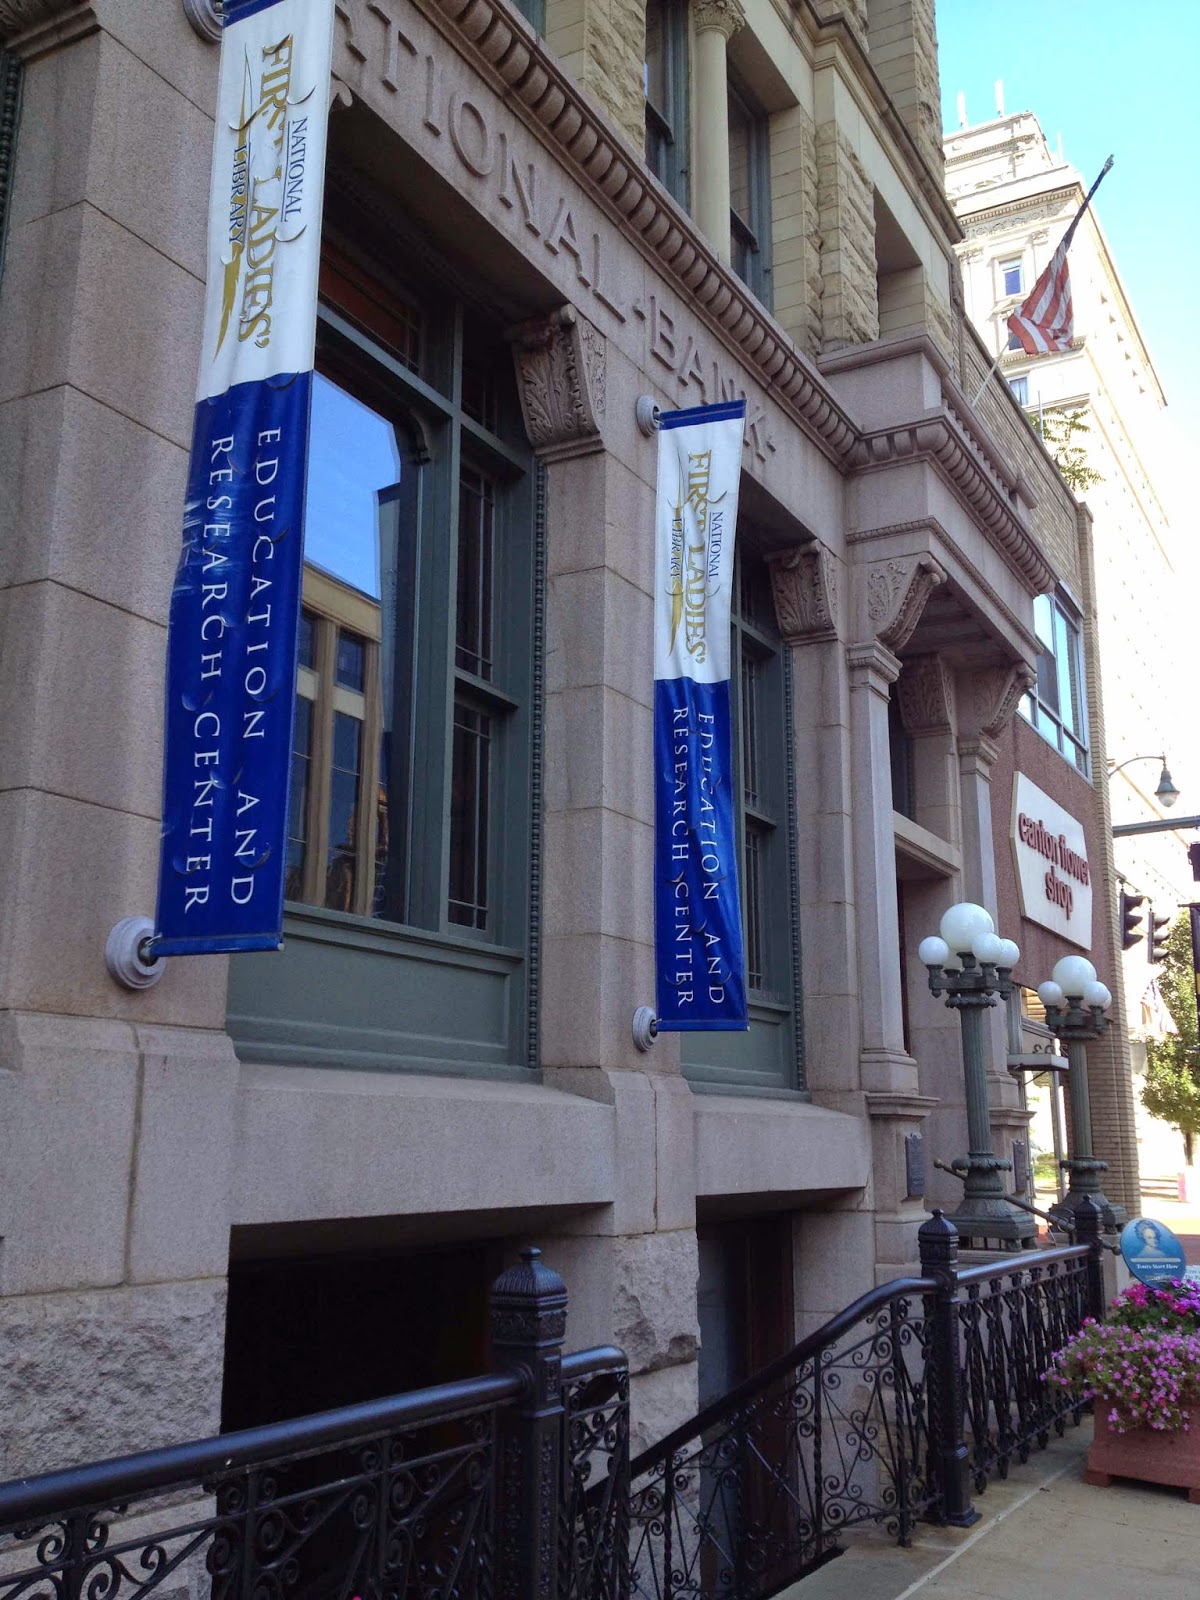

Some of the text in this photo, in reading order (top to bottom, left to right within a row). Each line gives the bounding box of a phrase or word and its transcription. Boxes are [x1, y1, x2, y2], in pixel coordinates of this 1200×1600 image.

[228, 143, 247, 244] LIBRARY
[284, 115, 309, 223] NATIONAL
[334, 2, 627, 323] TIONAL
[670, 518, 682, 578] LIBRARY
[707, 511, 723, 583] NATIONAL
[184, 433, 234, 915] RESEARCH CENTER
[230, 426, 282, 905] EDUCATION AND
[671, 705, 694, 1008] RESEARCH CENTER
[698, 712, 725, 1004] EDUCATION AND
[1018, 812, 1090, 886] canton flower
[1045, 864, 1074, 921] shop
